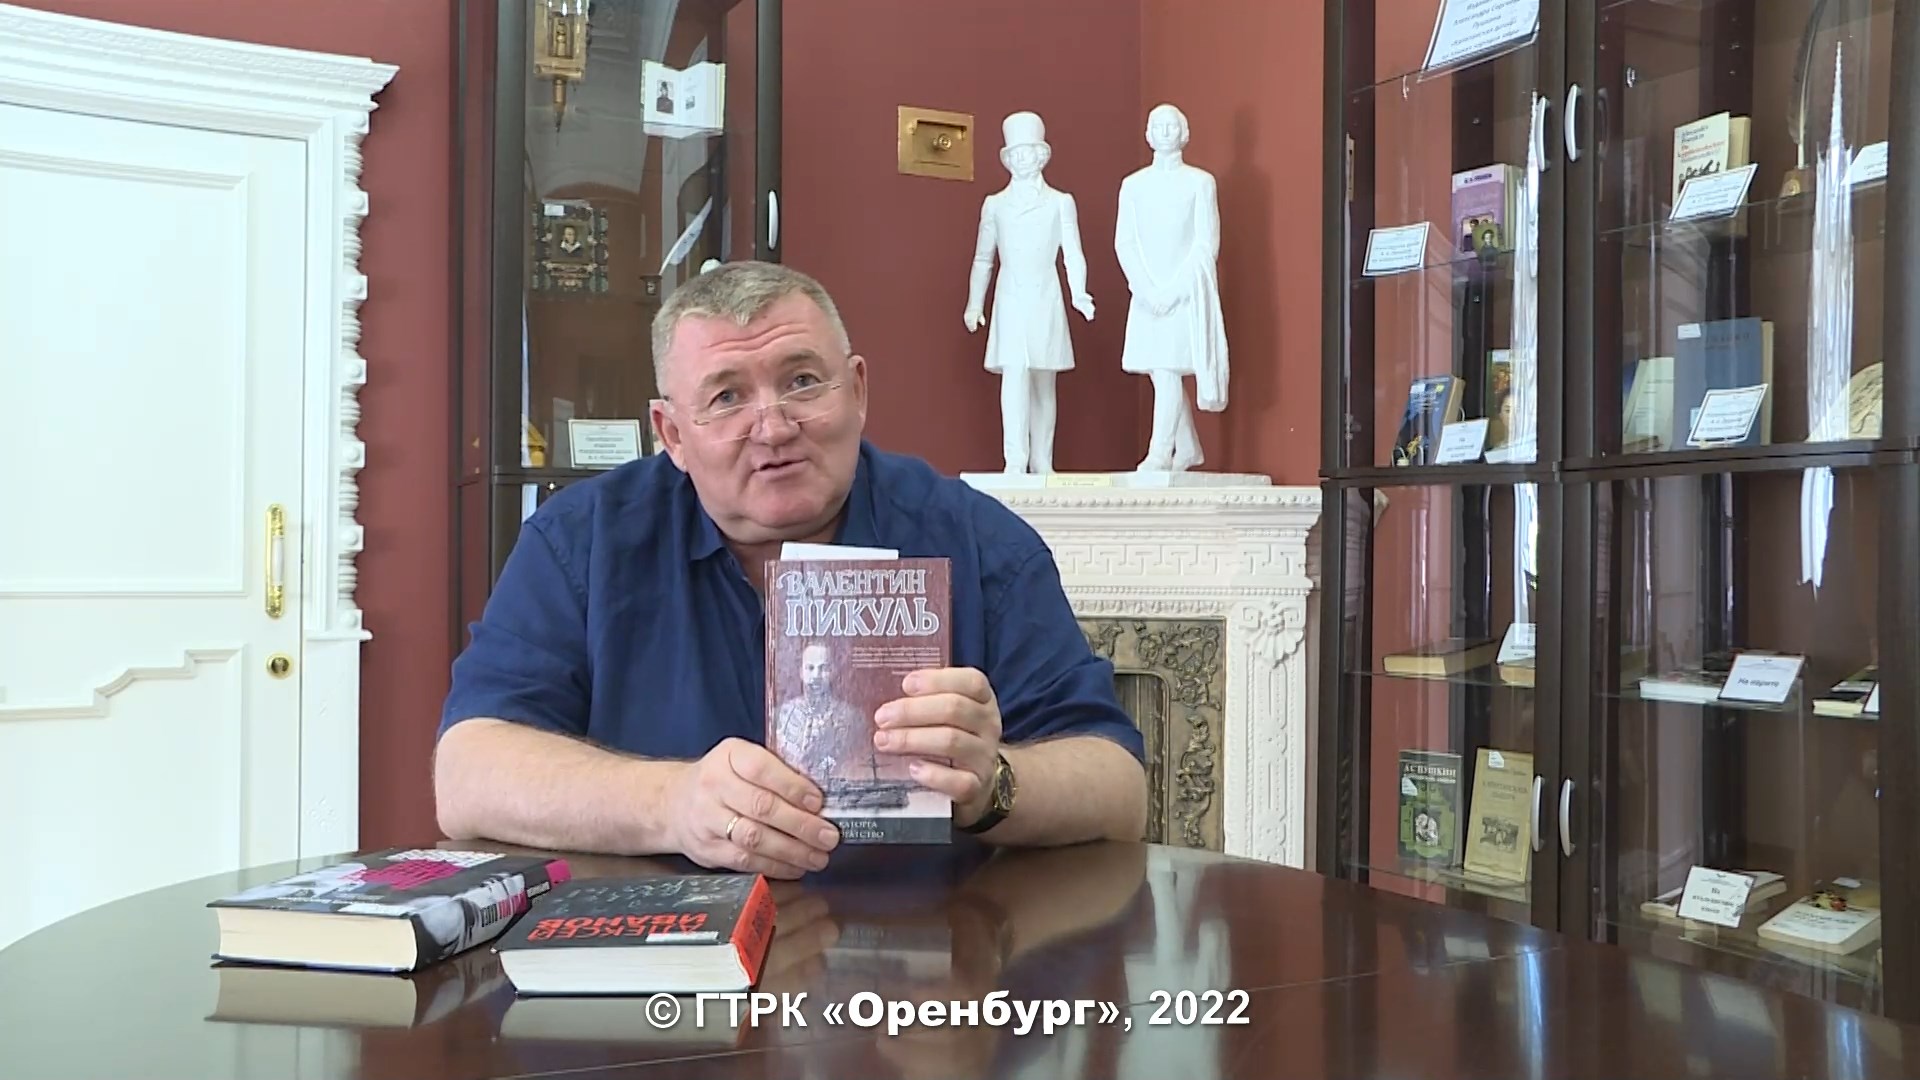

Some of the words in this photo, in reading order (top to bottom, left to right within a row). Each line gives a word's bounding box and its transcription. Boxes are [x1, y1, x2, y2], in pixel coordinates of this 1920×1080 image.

[776, 569, 926, 597] ВАЛЕНТИН
[785, 597, 940, 637] ПИКУЛЬ
[528, 922, 702, 942] АЛЕКСЕЙ
[535, 913, 708, 930] ИВАНОВ
